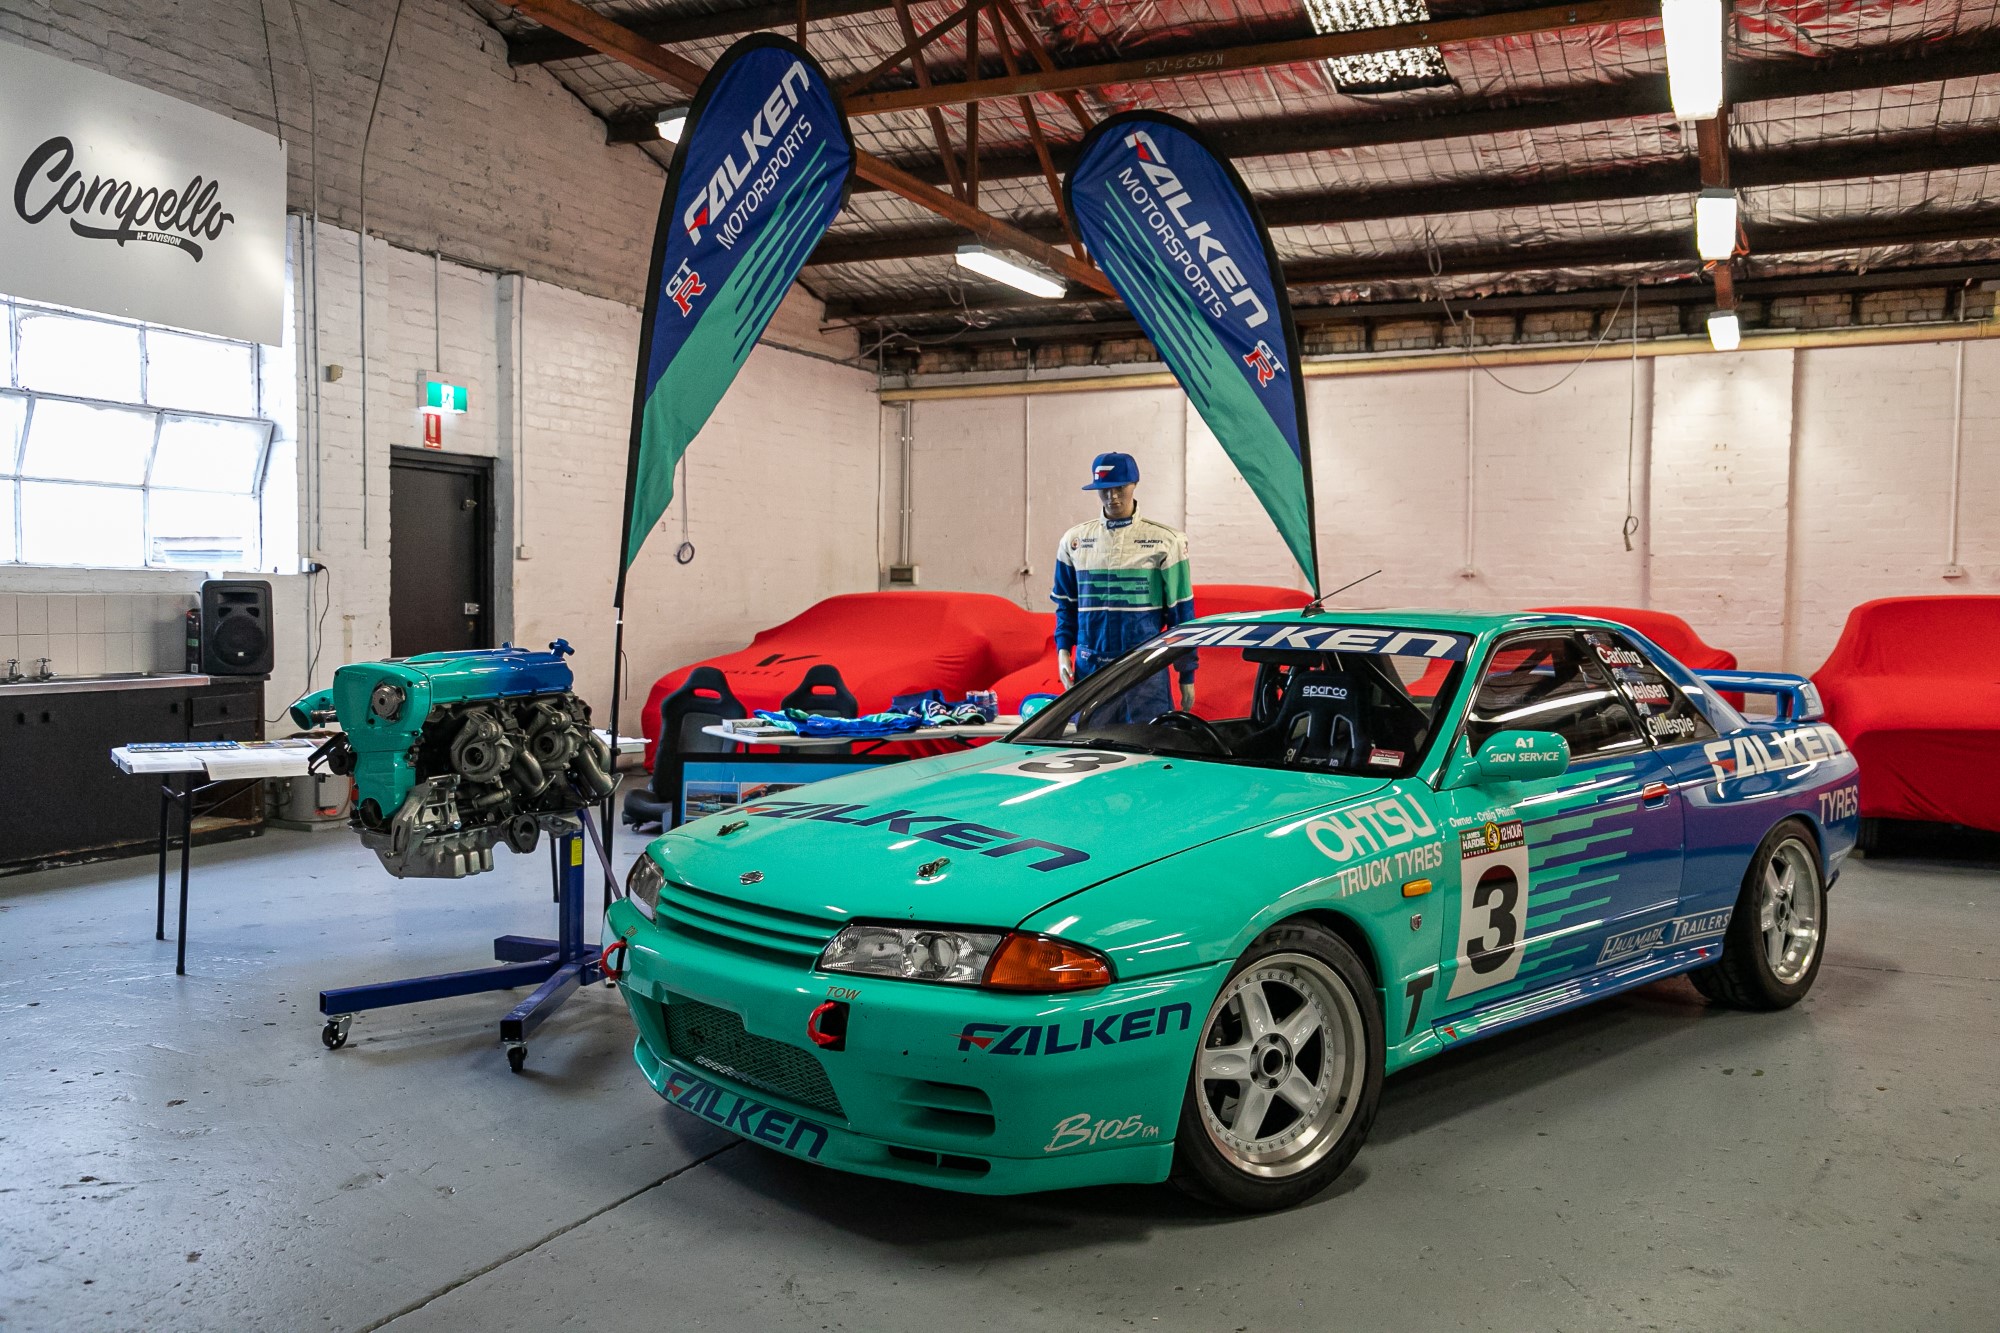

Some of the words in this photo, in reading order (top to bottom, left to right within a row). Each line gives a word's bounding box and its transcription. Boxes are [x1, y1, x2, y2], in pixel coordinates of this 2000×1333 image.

[684, 60, 810, 246] FALKEN
[14, 136, 235, 248] Compello
[716, 114, 812, 250] MOTORSPORTS
[1118, 167, 1228, 318] MOTORSPORTS
[1124, 129, 1269, 328] FALKEN
[665, 257, 692, 298] GT
[672, 271, 707, 318] R
[1242, 345, 1276, 388] R
[1256, 339, 1286, 374] GT
[1146, 625, 1458, 658] FALKEN
[1596, 646, 1644, 668] Carling
[1302, 685, 1348, 698] sparco
[1515, 737, 1534, 749] A1
[1646, 714, 1695, 738] Gillespie
[1018, 752, 1127, 774] 3
[1489, 753, 1516, 763] SIGN
[1518, 751, 1560, 763] SERVICE
[1704, 725, 1850, 783] FALKEN
[1449, 816, 1473, 828] Owner
[1476, 810, 1498, 822] Craig
[1818, 785, 1859, 825] TYRES
[718, 801, 1091, 872] FALKEN
[1305, 793, 1438, 862] OHTSU
[1462, 837, 1486, 850] HARDIE
[1466, 831, 1481, 840] JAMES
[1506, 824, 1523, 840] HOUR
[1336, 857, 1392, 897] TRUCK
[1395, 842, 1443, 878] TYRES
[1466, 864, 1518, 975] 3
[1603, 926, 1666, 960] HAULMARK
[1672, 913, 1731, 943] TRAILERS
[826, 986, 861, 1000] TOW
[1405, 972, 1434, 1037] T
[952, 1001, 1192, 1056] FALKEN
[663, 1071, 829, 1159] FALKEN
